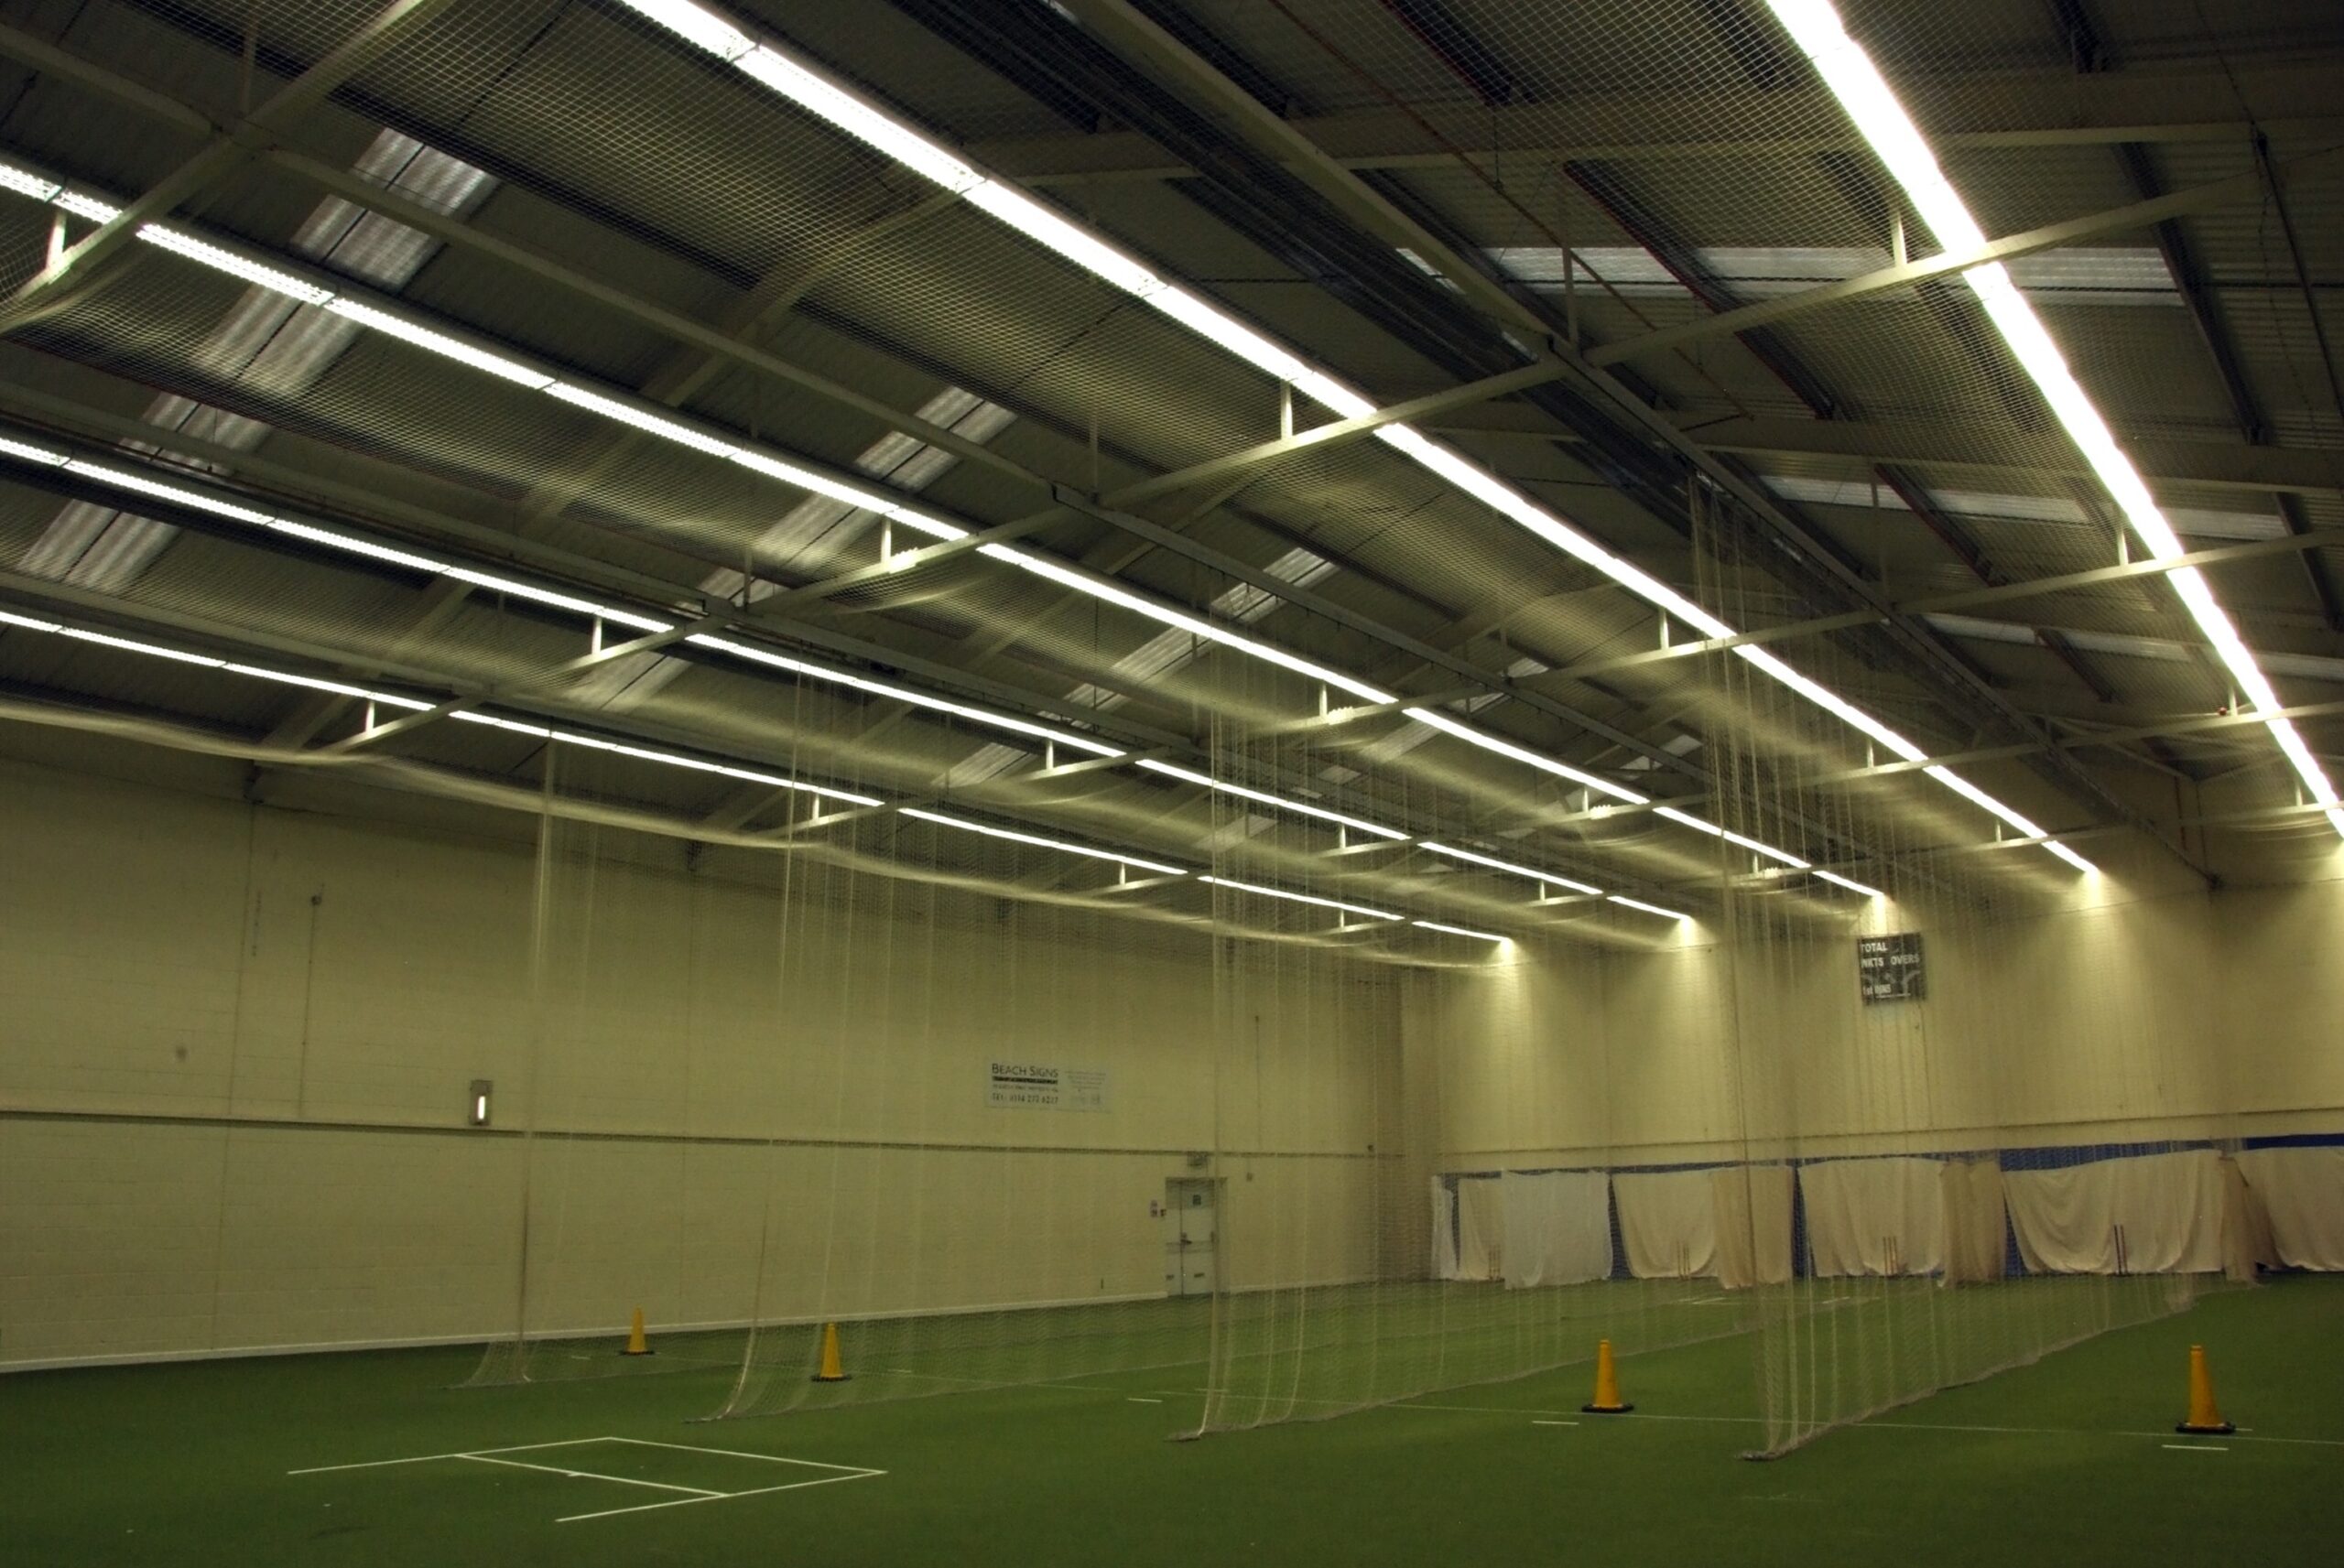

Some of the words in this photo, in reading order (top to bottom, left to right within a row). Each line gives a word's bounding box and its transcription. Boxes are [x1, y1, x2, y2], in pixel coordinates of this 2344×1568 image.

[1861, 942, 1888, 953] TOTAL
[1890, 954, 1920, 966] OVERS
[992, 1063, 1026, 1076] BEACH
[1029, 1065, 1058, 1078] SIGNS
